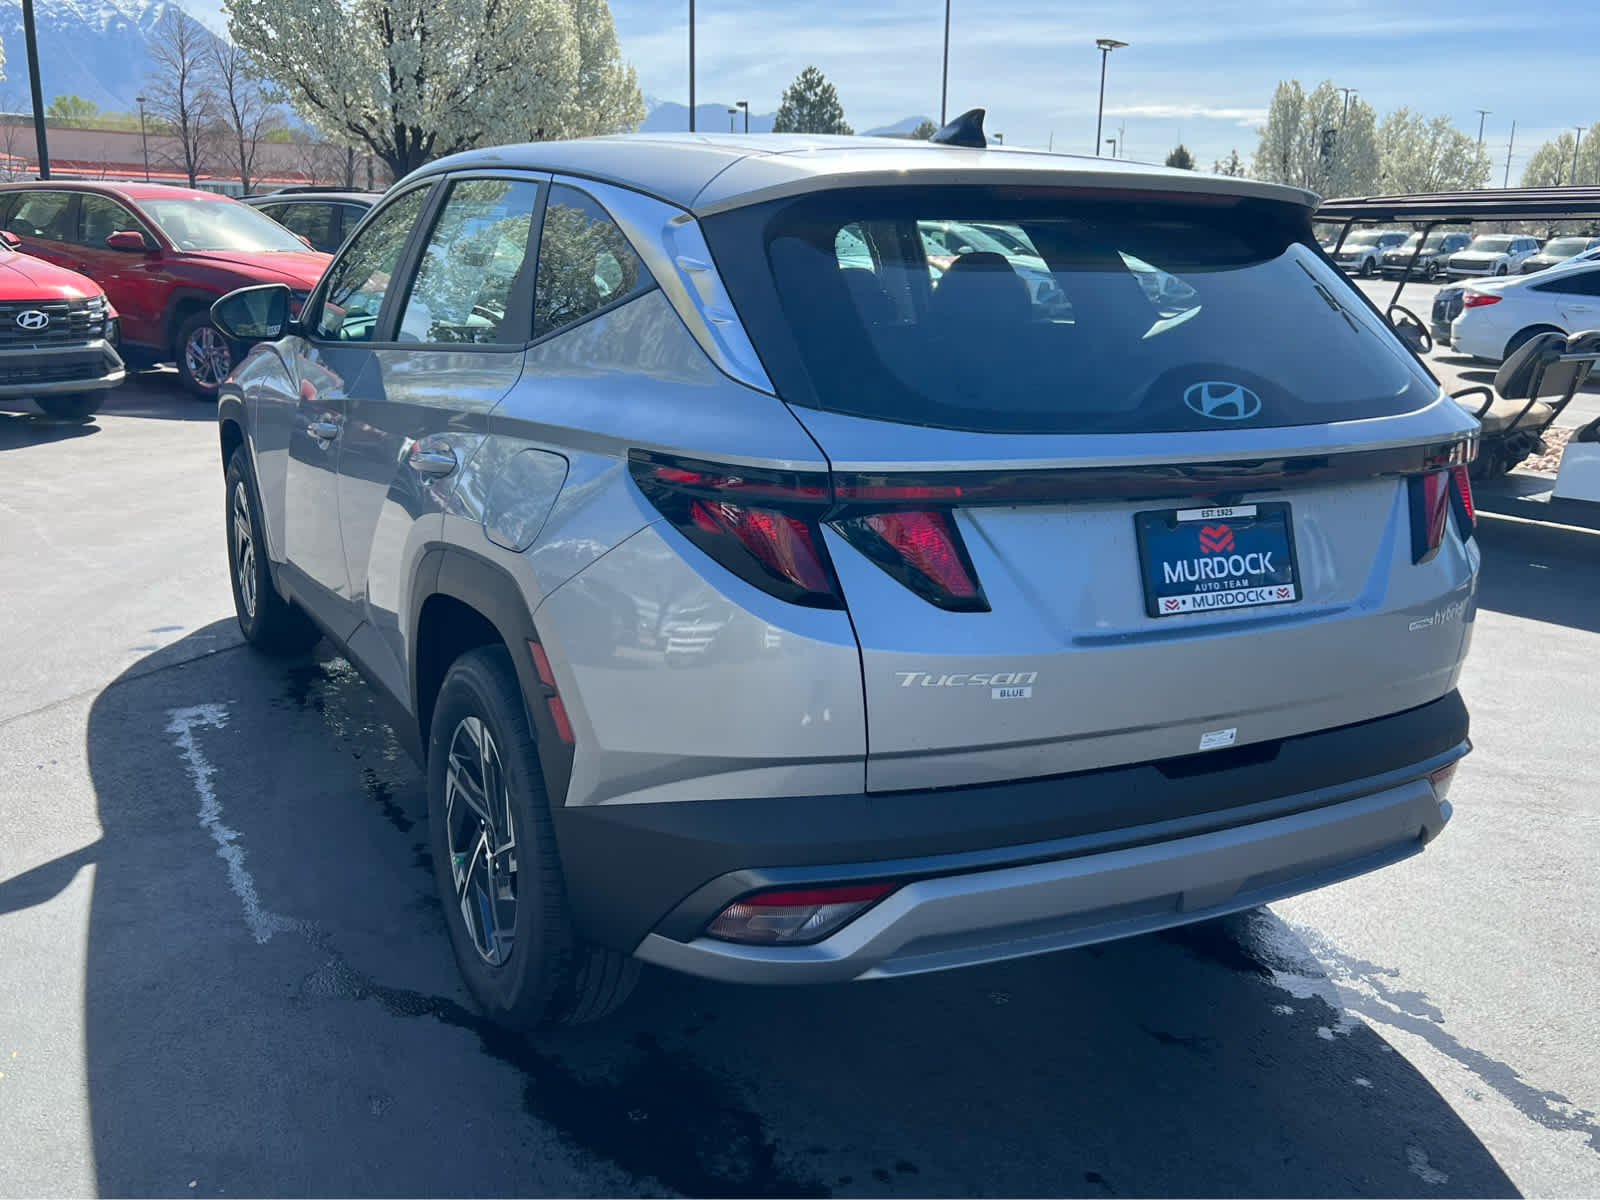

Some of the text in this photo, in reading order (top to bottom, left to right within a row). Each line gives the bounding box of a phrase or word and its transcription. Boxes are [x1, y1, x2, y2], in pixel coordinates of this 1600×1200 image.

[1163, 552, 1275, 584] MURDOCK
[1195, 579, 1249, 592] AUTO TEAM
[1192, 590, 1266, 609] MURDOCK
[999, 688, 1025, 698] BLUE
